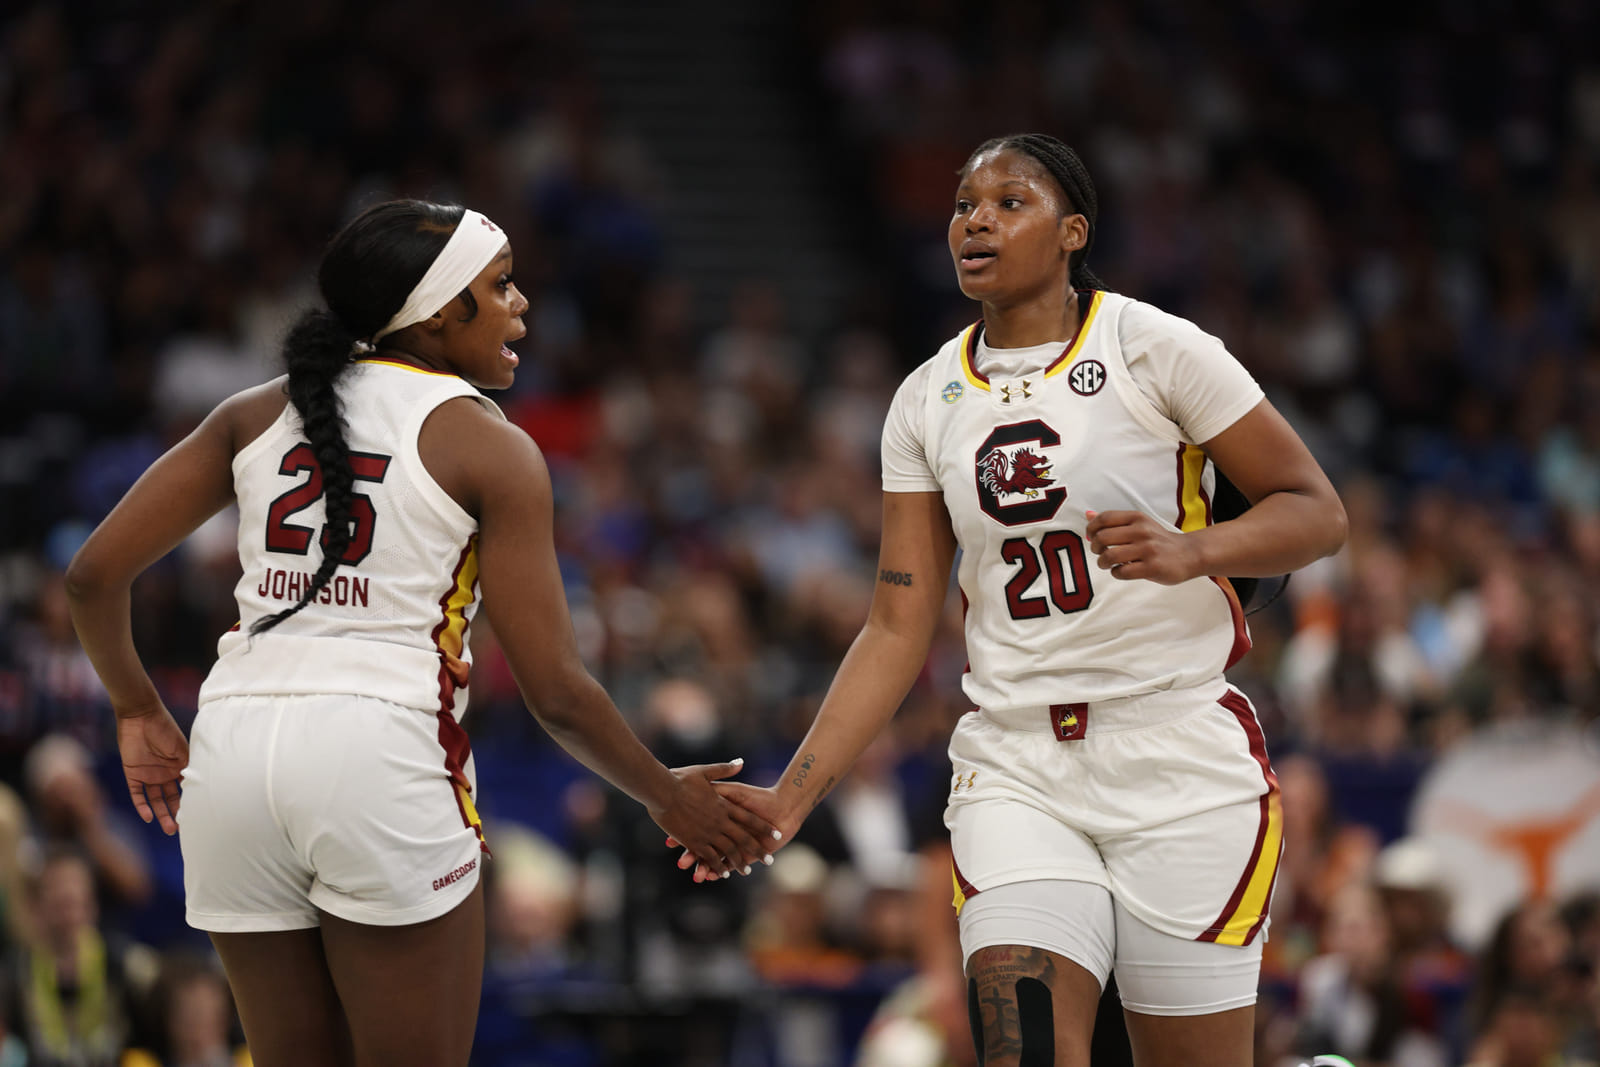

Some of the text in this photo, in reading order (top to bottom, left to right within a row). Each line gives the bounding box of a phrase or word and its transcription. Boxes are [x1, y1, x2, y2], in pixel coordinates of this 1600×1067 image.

[1071, 361, 1104, 393] SEC
[265, 442, 392, 567] 25
[1001, 530, 1094, 620] 20
[432, 858, 477, 891] GAMECOCKS
